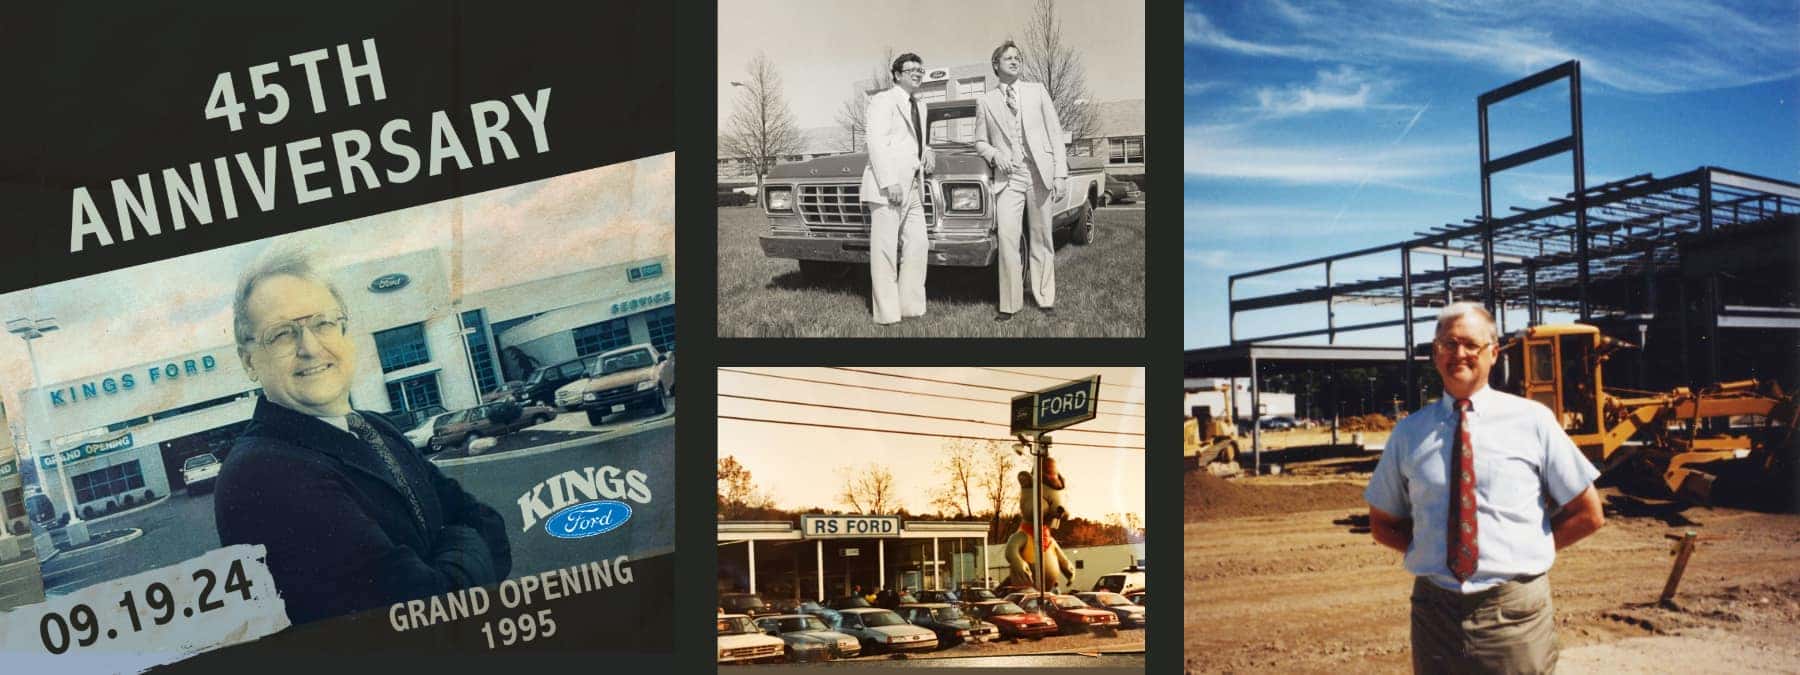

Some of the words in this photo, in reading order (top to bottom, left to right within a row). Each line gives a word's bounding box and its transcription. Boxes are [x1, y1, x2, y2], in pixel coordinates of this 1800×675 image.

[50, 374, 135, 407] KINGS
[149, 355, 215, 384] FORD
[1041, 390, 1086, 417] FORD
[85, 435, 130, 454] OPENING
[816, 520, 838, 533] RS
[847, 520, 892, 533] FORD
